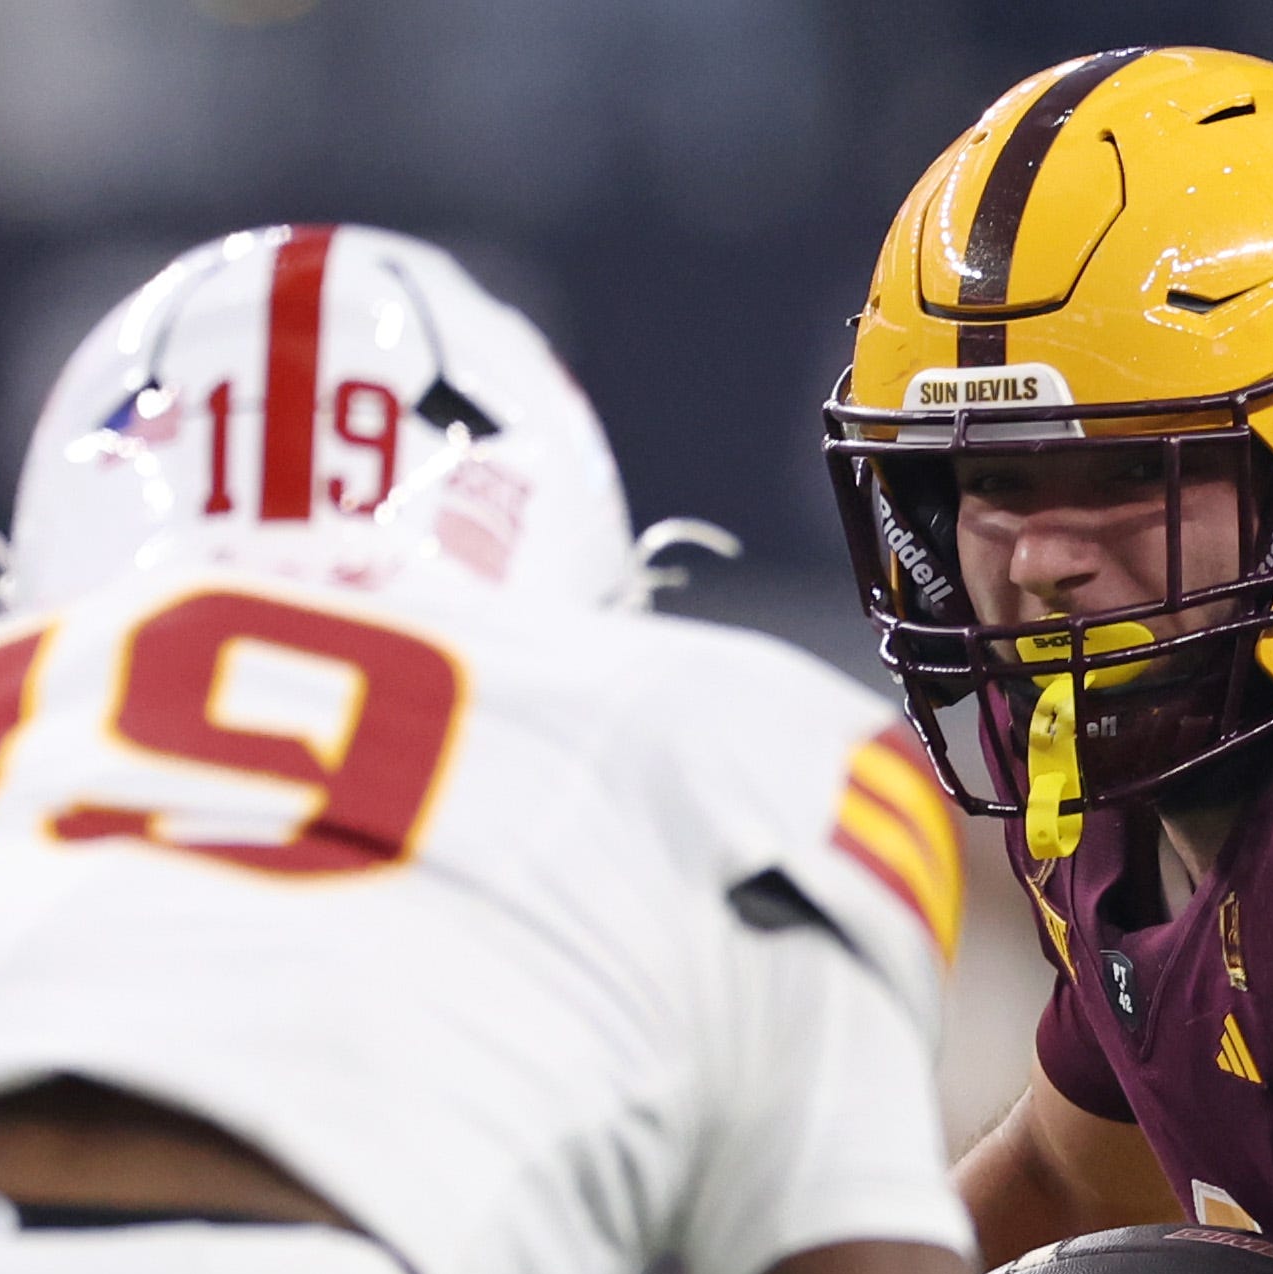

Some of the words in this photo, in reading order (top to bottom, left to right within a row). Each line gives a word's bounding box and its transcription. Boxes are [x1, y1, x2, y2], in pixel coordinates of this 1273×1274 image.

[920, 381, 958, 404] SUN
[965, 377, 1038, 402] DEVILS
[201, 380, 401, 516] 19
